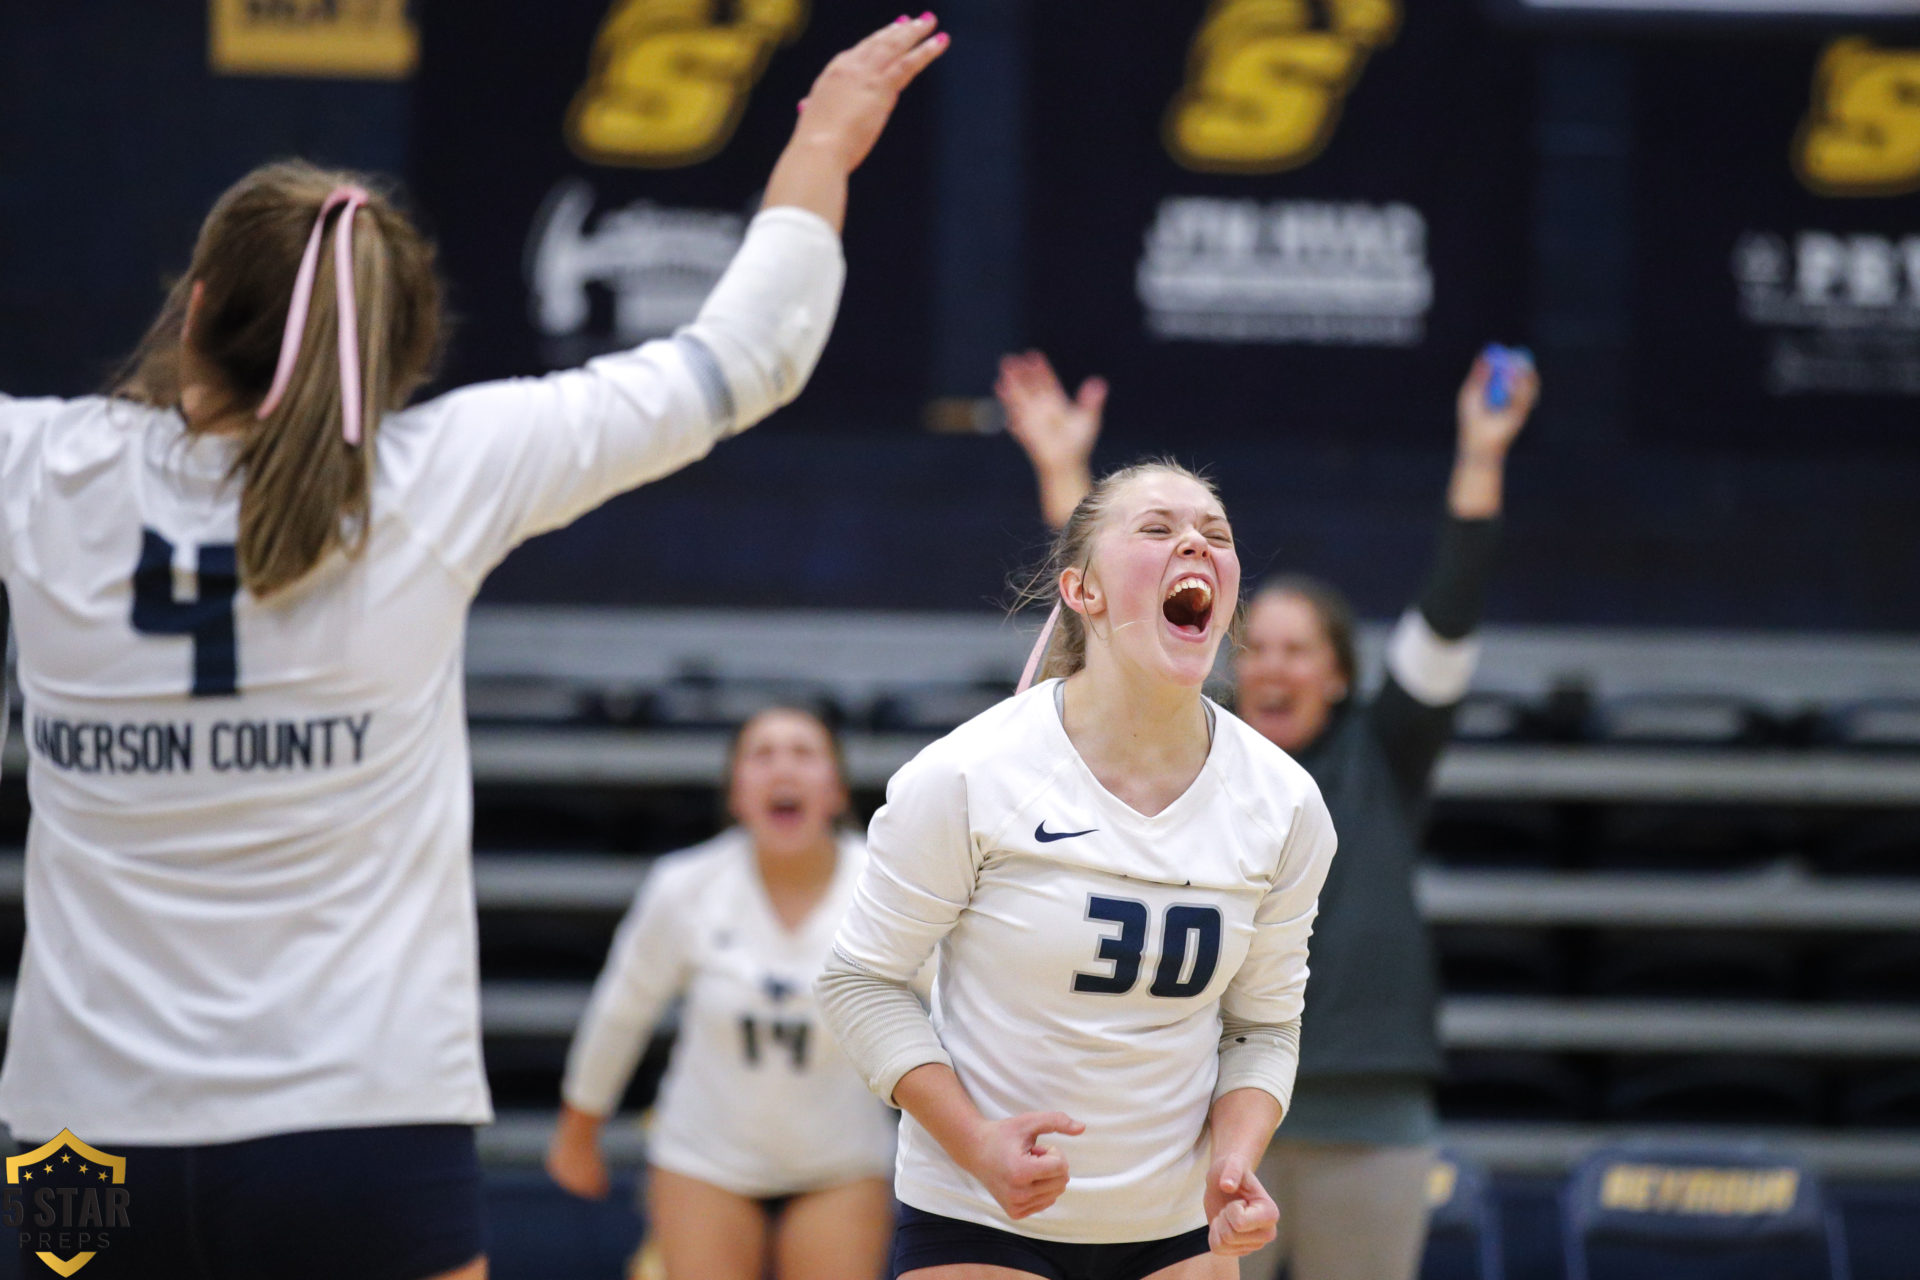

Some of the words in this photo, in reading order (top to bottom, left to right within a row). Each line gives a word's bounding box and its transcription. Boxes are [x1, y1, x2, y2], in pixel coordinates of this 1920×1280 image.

[131, 526, 240, 696] 4
[210, 711, 371, 774] COUNTY
[1070, 892, 1224, 1000] 30
[739, 1013, 813, 1071] 14
